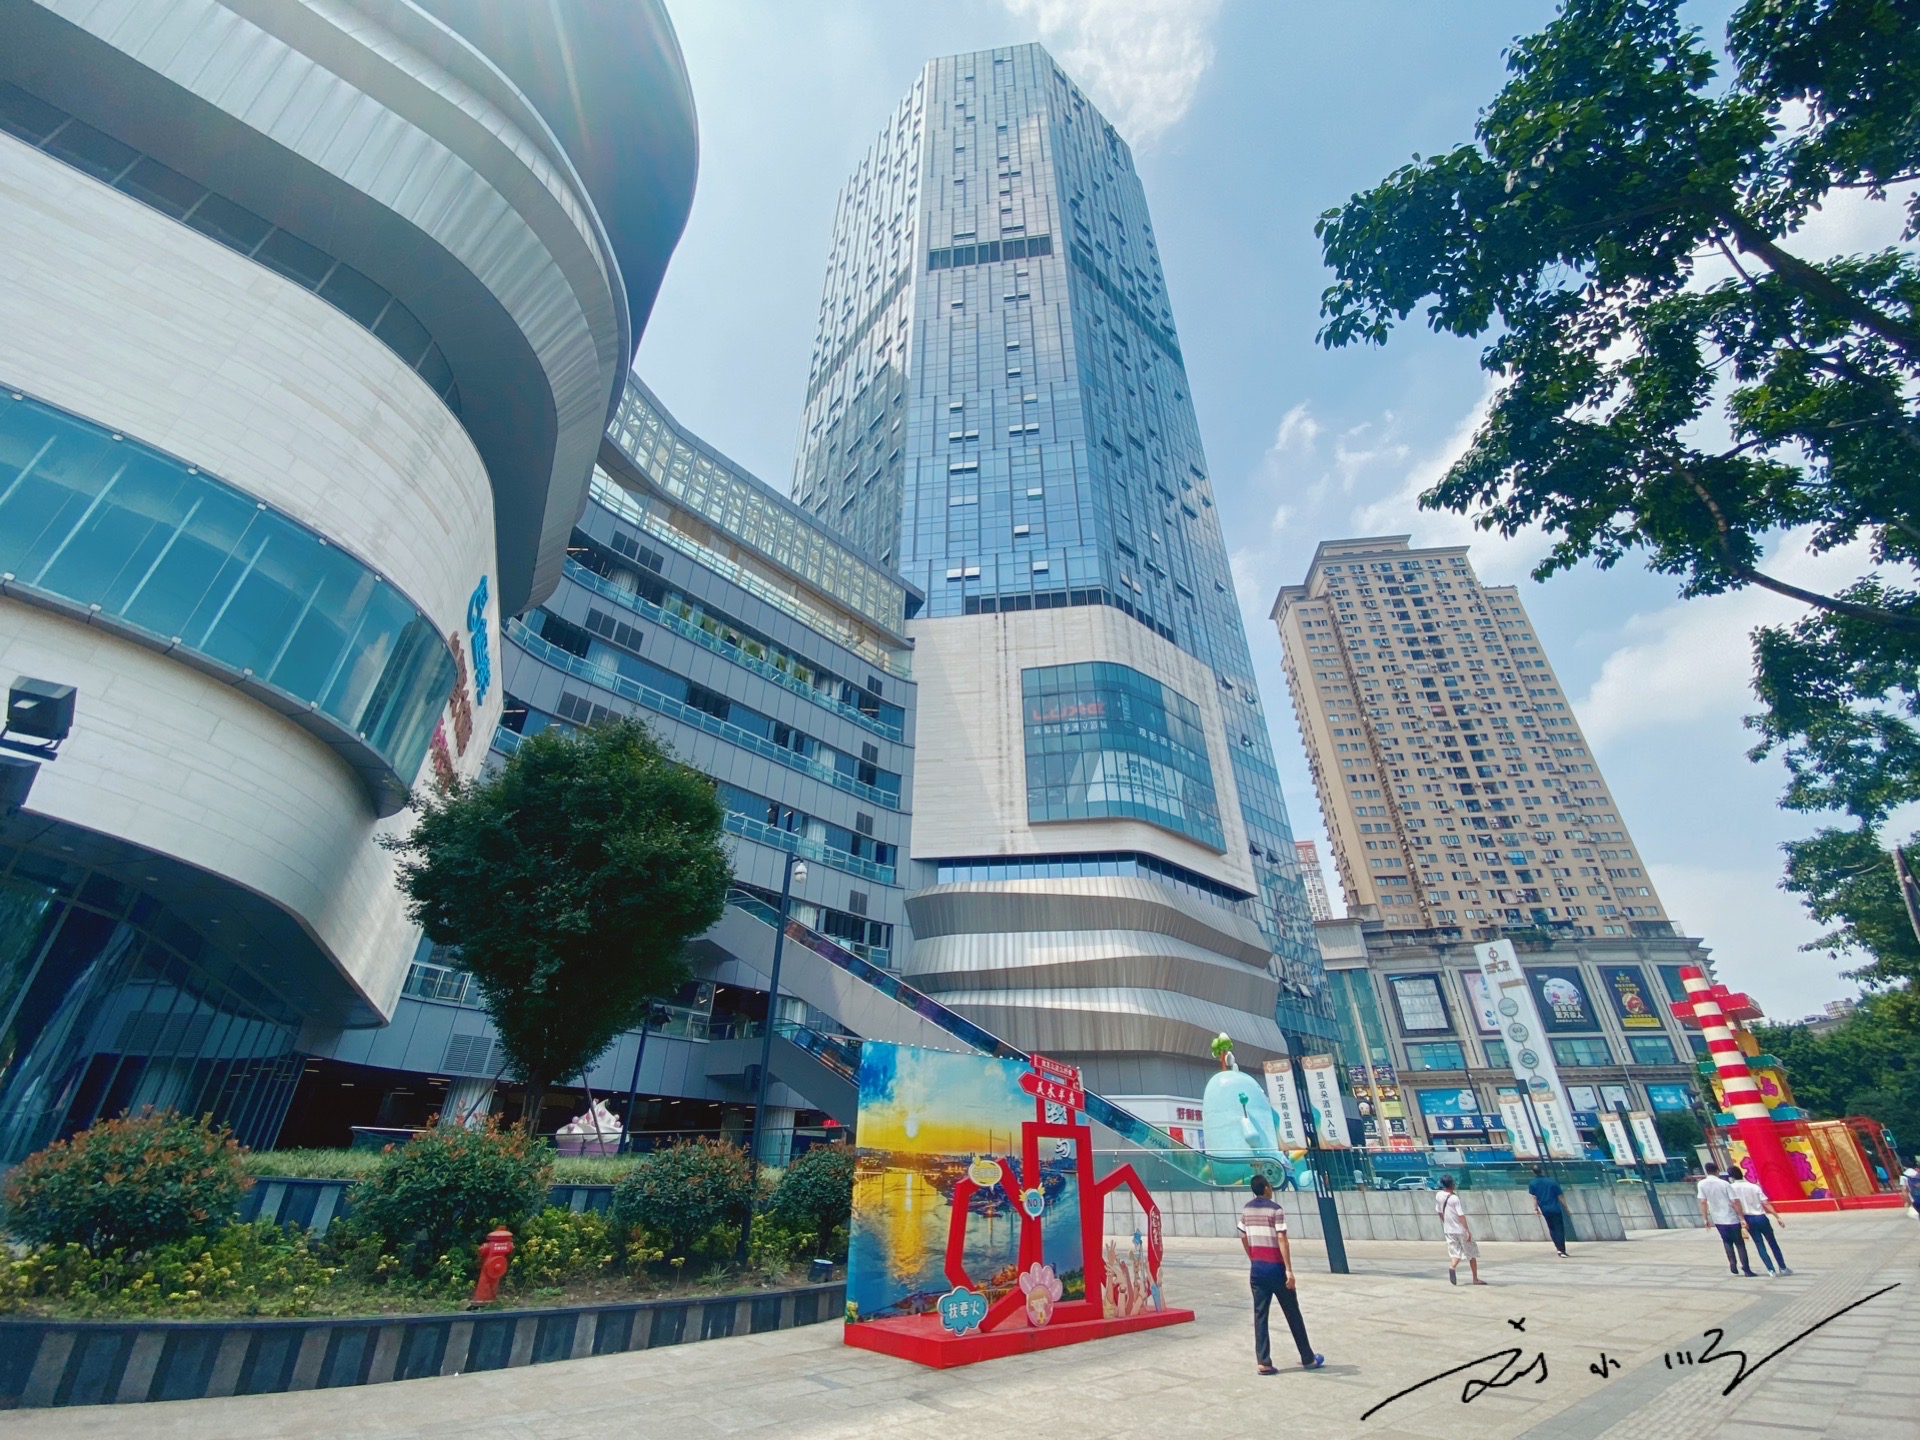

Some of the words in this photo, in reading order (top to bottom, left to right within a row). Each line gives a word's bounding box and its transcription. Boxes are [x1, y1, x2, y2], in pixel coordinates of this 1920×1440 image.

[1460, 1116, 1506, 1129] 燕京
[947, 1302, 980, 1318] 我要火
